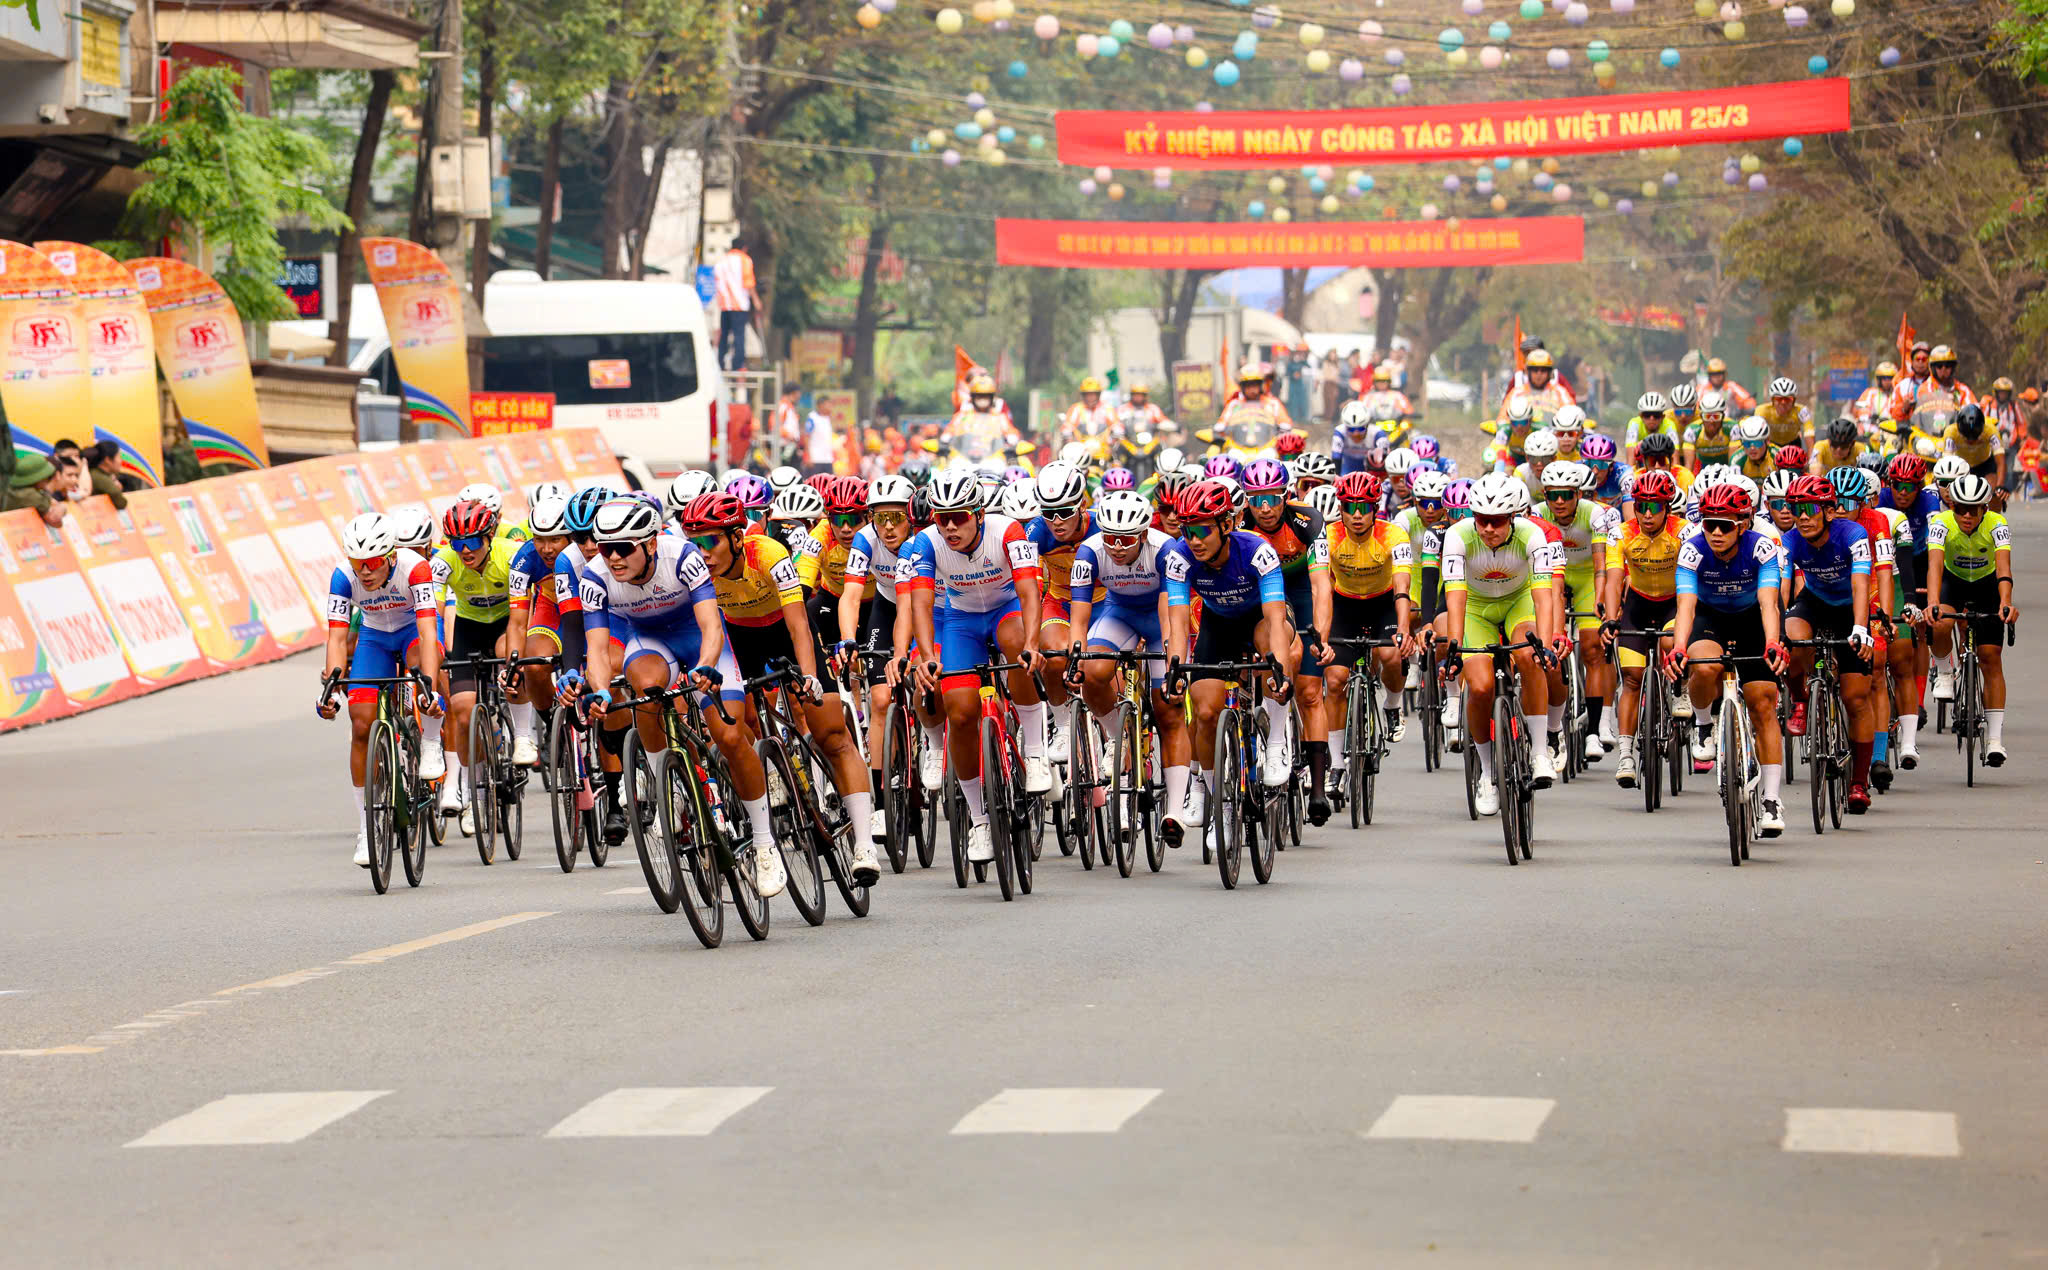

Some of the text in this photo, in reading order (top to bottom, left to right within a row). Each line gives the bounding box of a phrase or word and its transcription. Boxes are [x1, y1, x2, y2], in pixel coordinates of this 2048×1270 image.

[1125, 104, 1750, 159] KỶ NIỆM NGÀY CÔNG TÁC XÃ HỘI VIỆT NAM 25/3
[1930, 527, 1944, 539] 66
[1996, 529, 2009, 541] 66
[1423, 535, 1437, 549] 36
[1757, 540, 1773, 555] 73
[1856, 541, 1870, 557] 71
[1015, 545, 1032, 561] 13
[1256, 550, 1275, 566] 74
[1394, 546, 1412, 560] 146
[1543, 552, 1549, 567] 7
[1551, 545, 1564, 560] 23
[1682, 546, 1699, 563] 73
[681, 557, 706, 583] 104
[849, 554, 864, 570] 17
[1168, 556, 1183, 574] 74
[1447, 559, 1456, 574] 7
[774, 563, 797, 584] 141
[415, 587, 431, 603] 15
[581, 584, 603, 606] 104
[331, 599, 348, 615] 15
